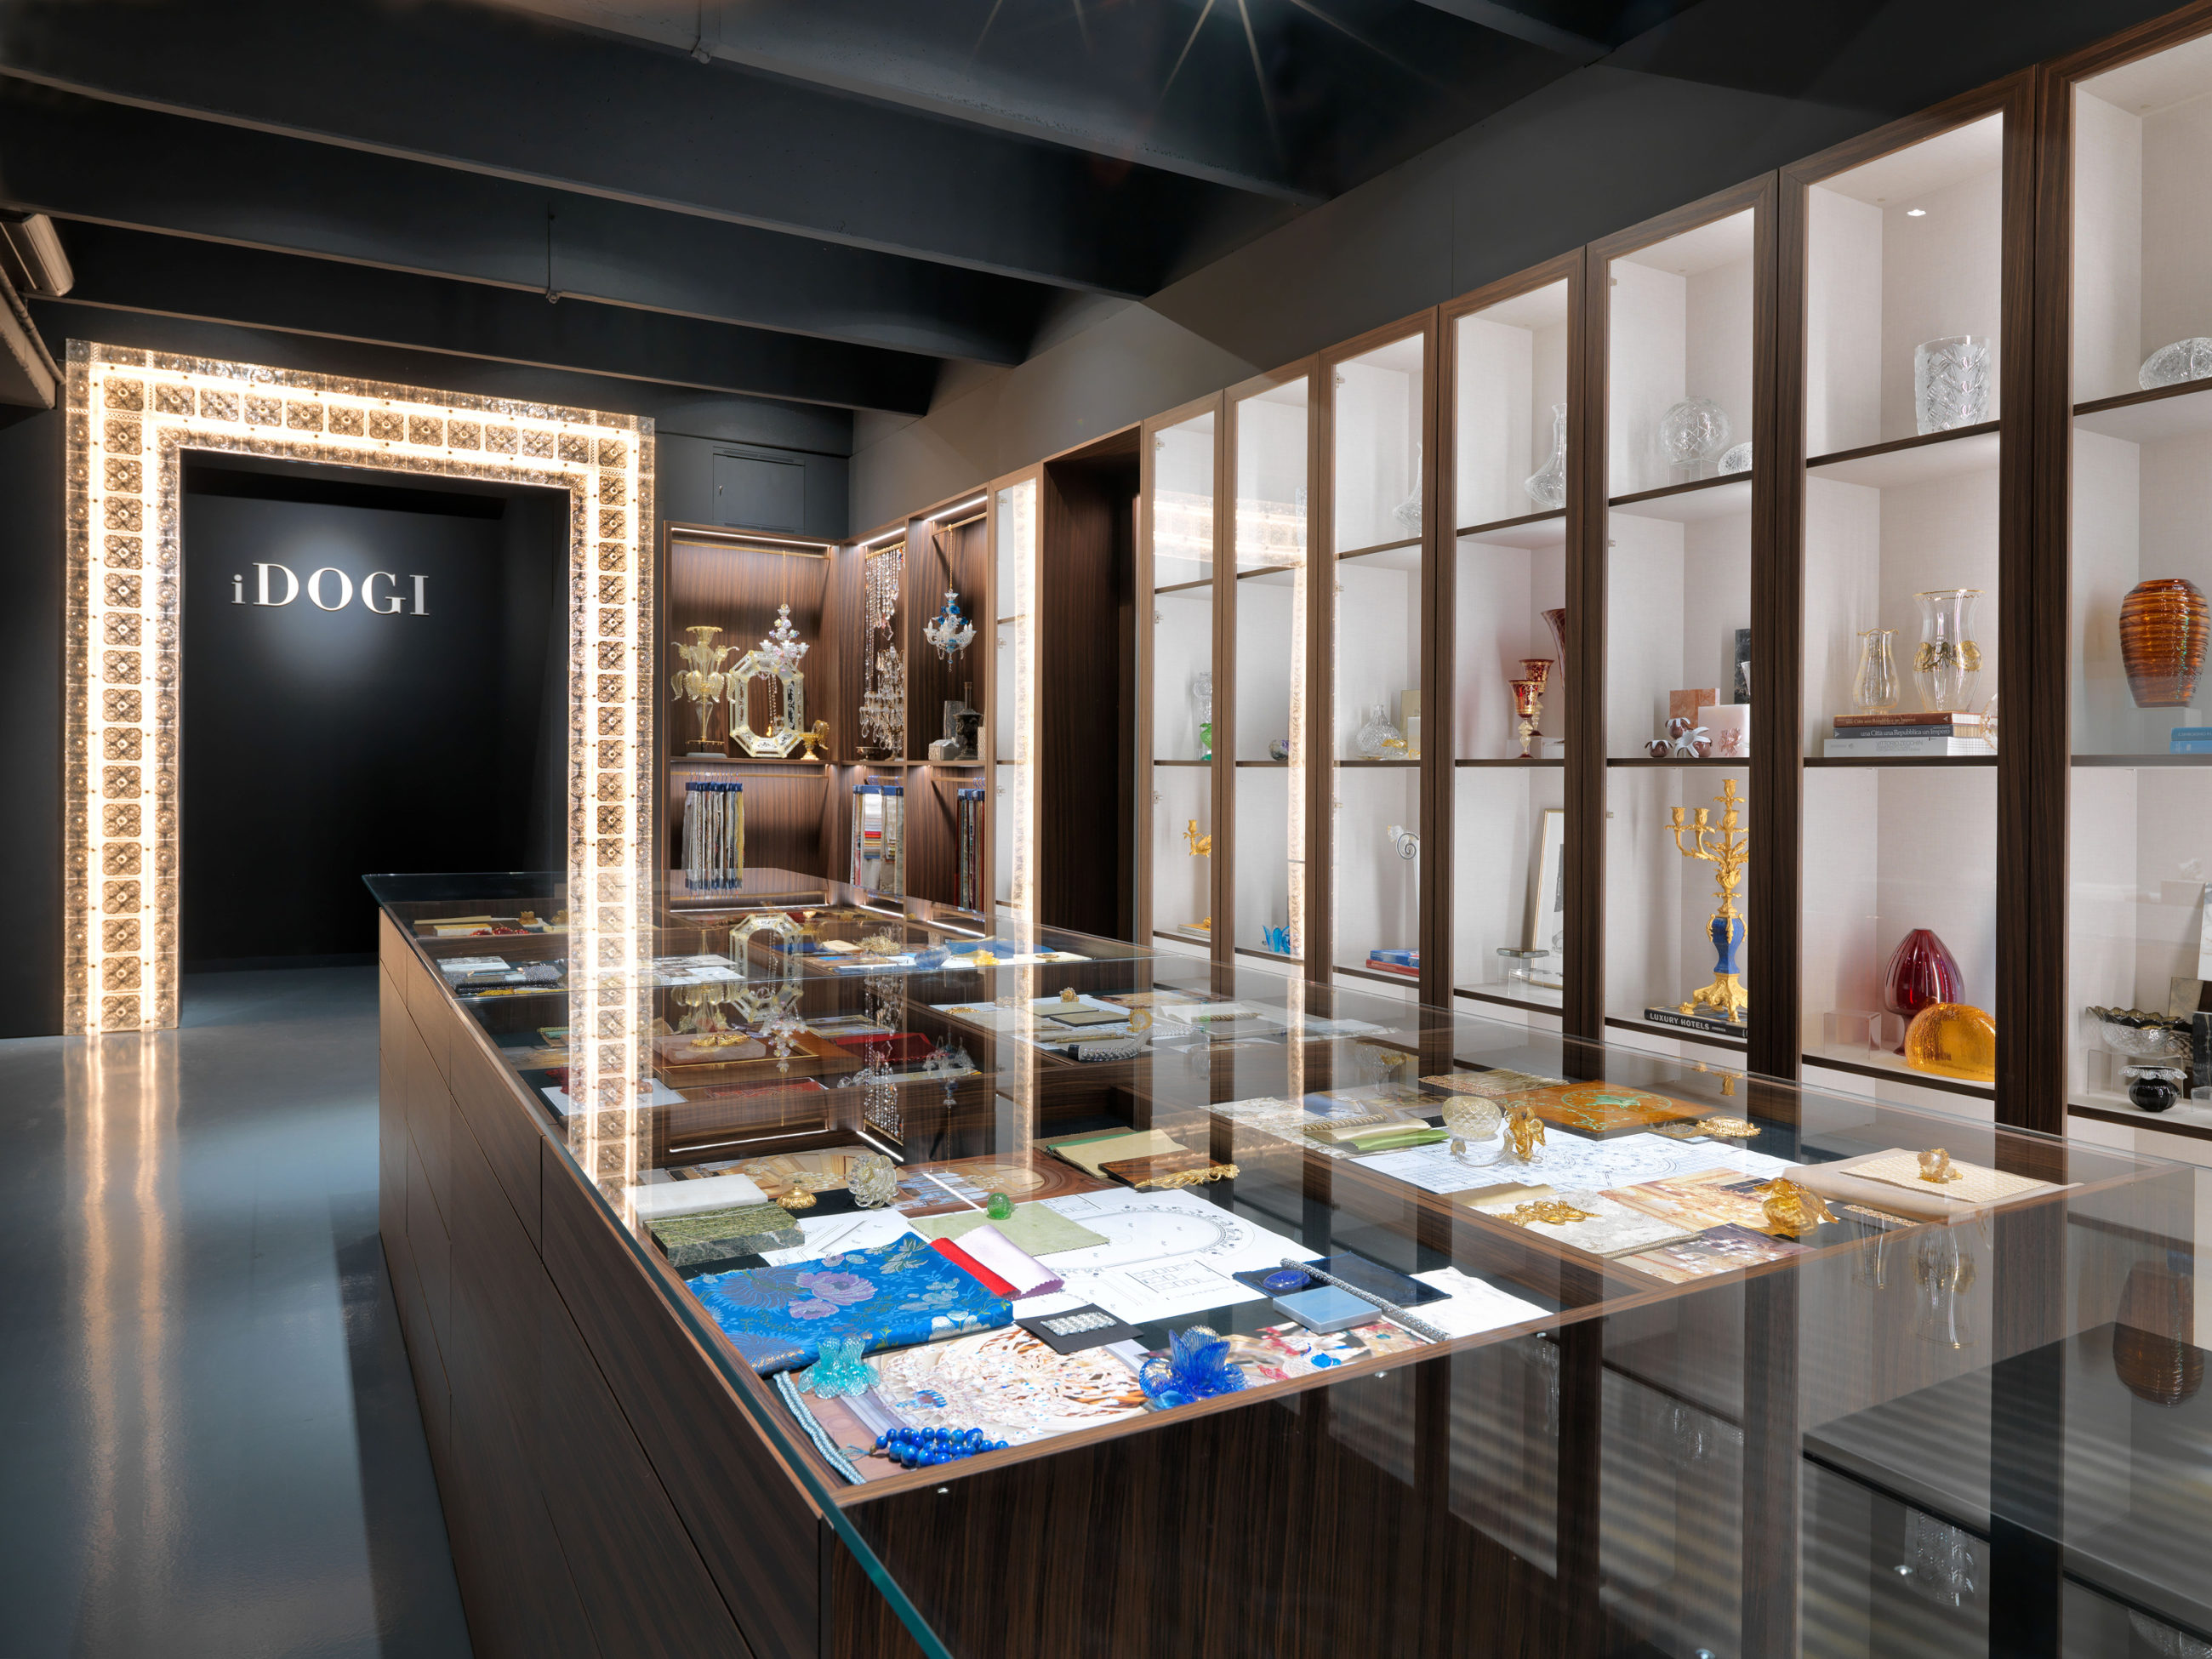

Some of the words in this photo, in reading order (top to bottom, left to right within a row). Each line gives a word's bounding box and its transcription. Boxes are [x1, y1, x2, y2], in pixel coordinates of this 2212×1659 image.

[231, 562, 430, 615] iDOGI
[1893, 728, 1921, 737] Repubblica
[1650, 1013, 1678, 1024] LUXURY
[1680, 1018, 1709, 1030] HOTELS
